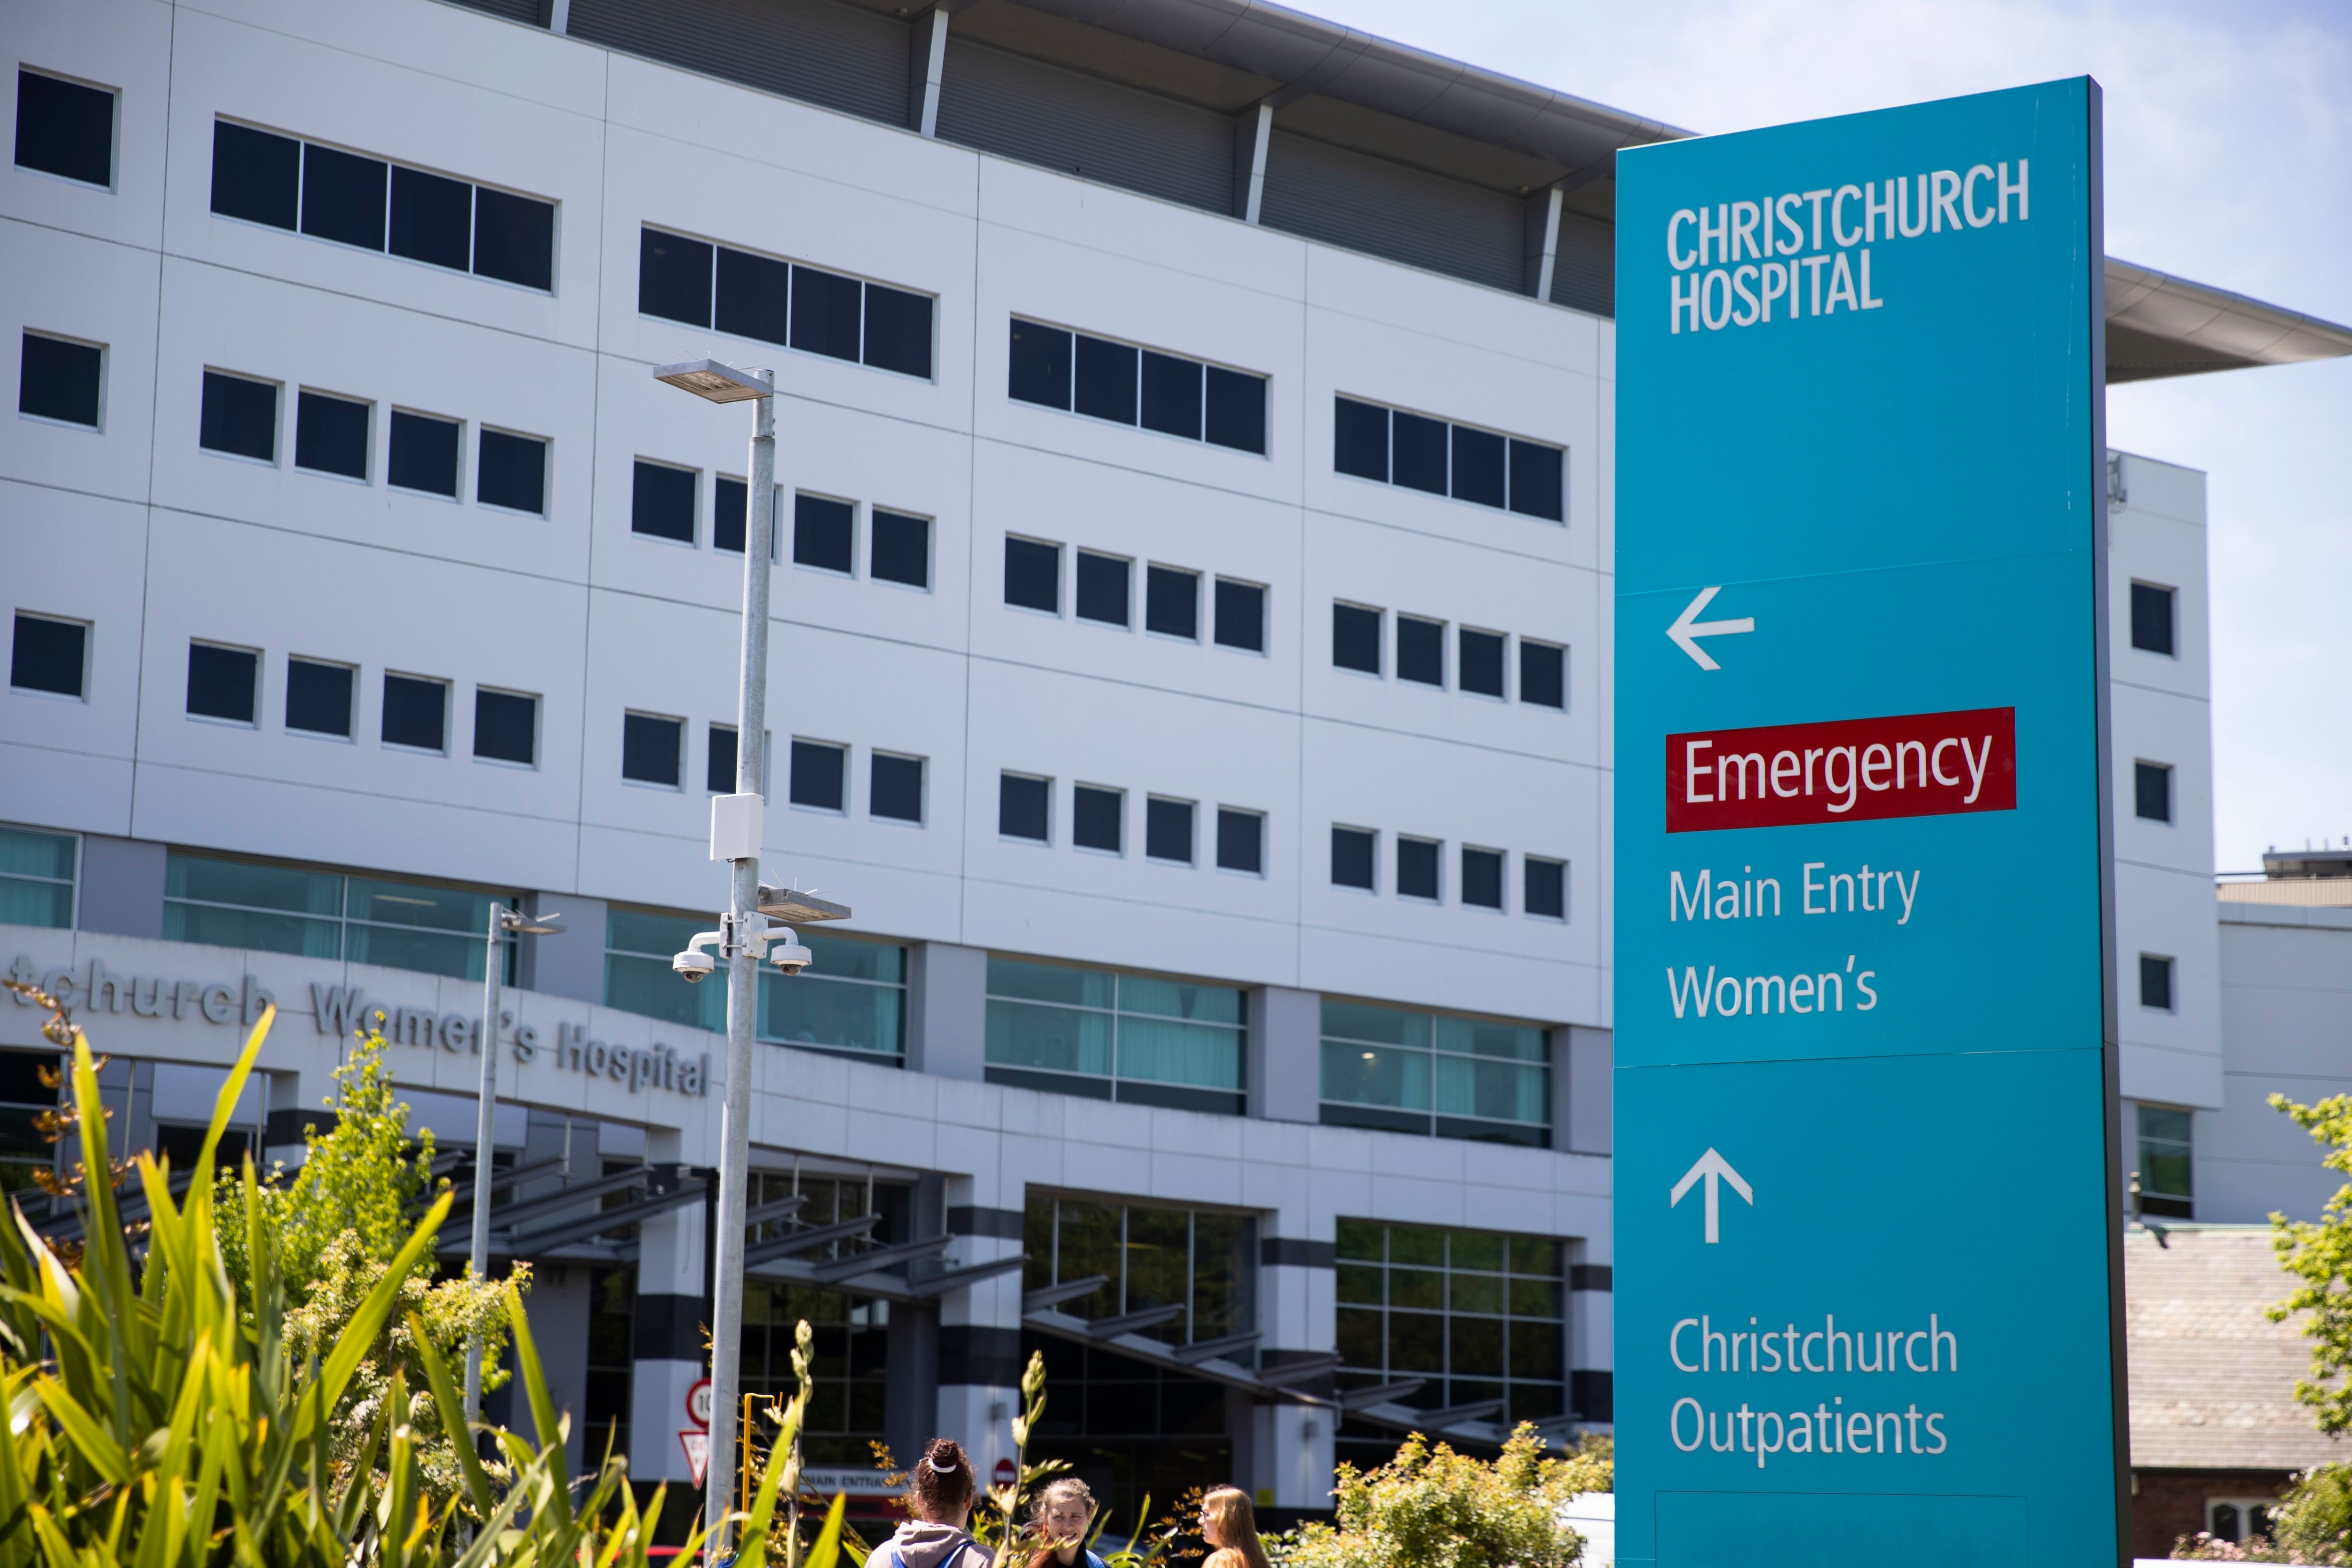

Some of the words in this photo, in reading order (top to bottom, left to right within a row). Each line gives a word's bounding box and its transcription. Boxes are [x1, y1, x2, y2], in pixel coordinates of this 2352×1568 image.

[1667, 159, 2029, 271] CHRISTCHURCH
[1670, 248, 1883, 334] HOSPITAL
[1686, 735, 1993, 813] Emergency
[1670, 865, 1780, 922] Main
[1803, 862, 1921, 925] Entry
[1666, 954, 1877, 1019] Women's
[556, 1021, 712, 1098] Hospital
[1669, 1313, 1957, 1373] Christchurch
[1670, 1396, 1947, 1469] Outpatients
